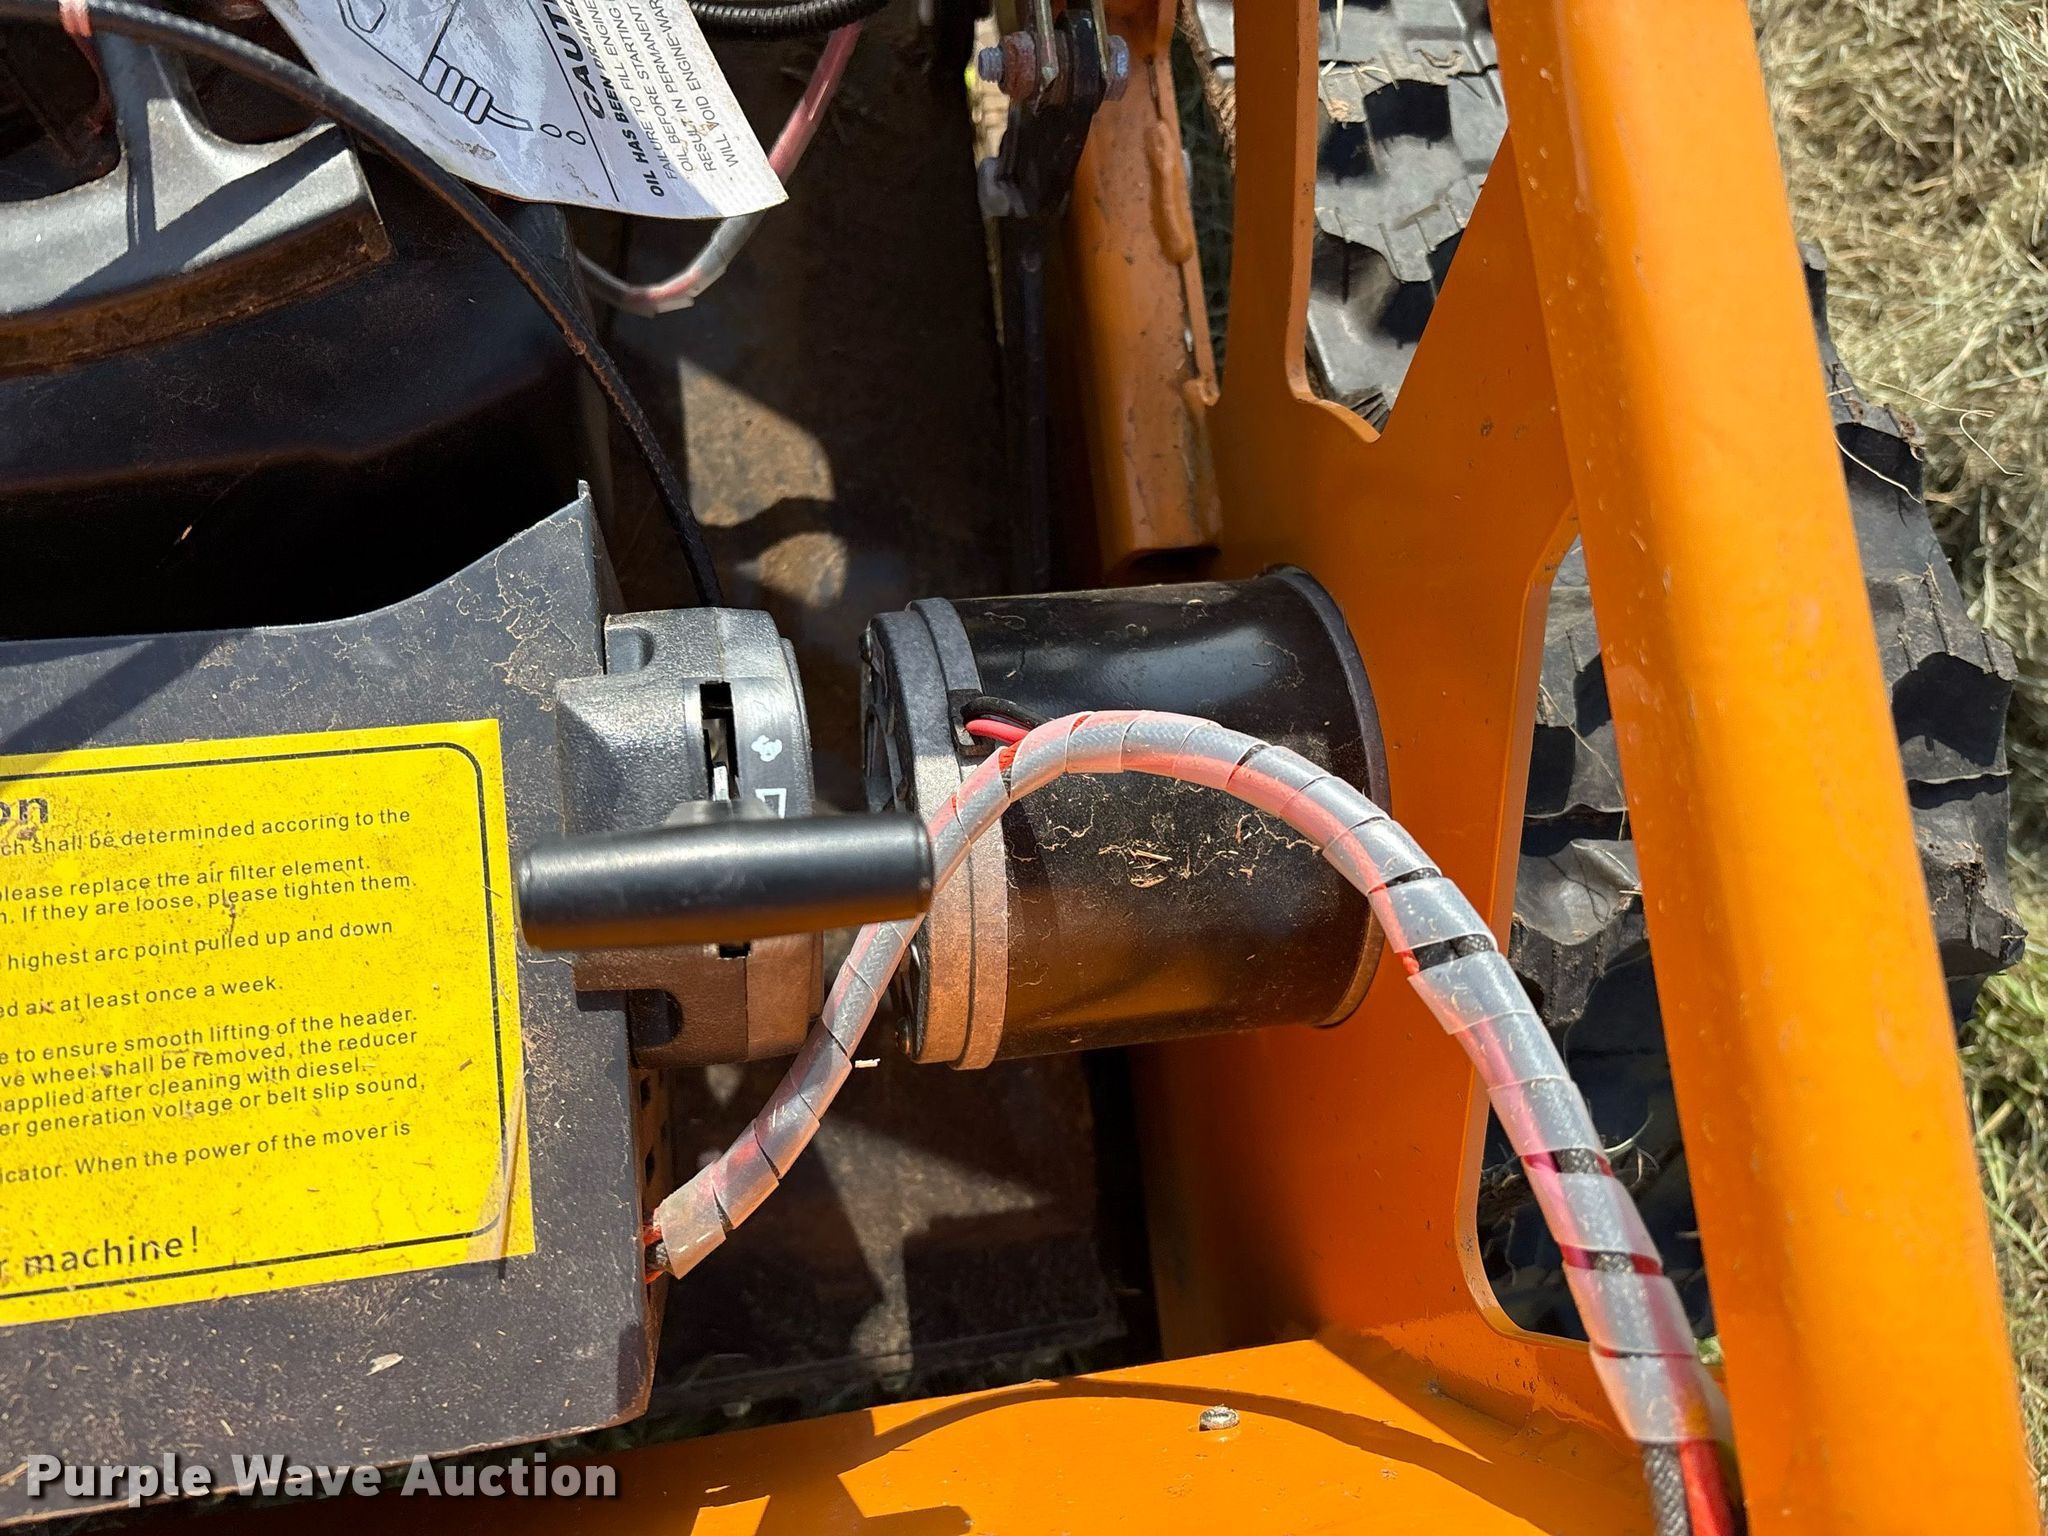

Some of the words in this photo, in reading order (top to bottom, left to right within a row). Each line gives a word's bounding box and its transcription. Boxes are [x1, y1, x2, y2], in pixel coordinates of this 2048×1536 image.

[584, 0, 618, 56] ENGINE
[609, 8, 649, 80] STARTING
[627, 3, 678, 93] PERMANENT
[614, 62, 634, 90] FILL
[666, 35, 701, 91] ENGINE
[600, 75, 629, 123] BEEN
[629, 95, 645, 115] TO
[643, 85, 680, 144] BEFORE
[671, 99, 688, 112] IN
[695, 96, 720, 131] VOID
[622, 129, 649, 164] HAS
[641, 121, 677, 180] FAILURE
[677, 146, 693, 171] OIL
[681, 118, 717, 172] RESULT
[715, 133, 739, 168] WILL
[643, 170, 664, 197] OIL
[32, 834, 82, 853] shall
[90, 833, 114, 848] be
[121, 820, 255, 846] determinded
[262, 814, 349, 834] accoring
[355, 812, 373, 827] to
[380, 809, 410, 823] the
[23, 905, 37, 922] If
[43, 904, 88, 921] they
[95, 900, 129, 916] are
[136, 895, 201, 912] loose,
[208, 888, 277, 909] please
[284, 880, 354, 900] tighten
[361, 875, 416, 891] them.
[71, 877, 150, 897] replace
[158, 872, 190, 888] the
[197, 869, 224, 884] air
[230, 864, 276, 881] filter
[282, 855, 370, 876] element.
[8, 948, 88, 972] highest
[95, 947, 128, 962] arc
[135, 939, 188, 961] point
[195, 931, 258, 955] pulled
[266, 931, 290, 947] up
[297, 924, 333, 942] and
[340, 921, 392, 938] down
[61, 996, 80, 1012] at
[87, 990, 140, 1008] least
[145, 986, 197, 1003] once
[204, 984, 215, 997] a
[222, 976, 283, 994] week.
[16, 1048, 36, 1063] to
[43, 1041, 117, 1060] ensure
[124, 1029, 203, 1051] smooth
[211, 1023, 270, 1042] lifting
[276, 1018, 296, 1035] of
[302, 1016, 334, 1032] the
[340, 1008, 417, 1028] header.
[32, 1062, 95, 1085] wheel
[101, 1055, 153, 1078] shall
[161, 1055, 186, 1071] be
[193, 1042, 293, 1068] removed,
[300, 1039, 332, 1055] the
[339, 1031, 417, 1051] reducer
[27, 1107, 146, 1137] generation
[153, 1098, 233, 1118] voltage
[240, 1095, 260, 1109] or
[267, 1086, 306, 1105] belt
[313, 1082, 349, 1100] slip
[355, 1074, 425, 1095] sound,
[92, 1083, 142, 1100] after
[149, 1073, 240, 1097] cleaning
[247, 1066, 290, 1084] with
[75, 1156, 137, 1175] When
[144, 1151, 178, 1168] the
[185, 1142, 251, 1166] power
[257, 1135, 277, 1153] of
[284, 1133, 316, 1149] the
[323, 1125, 388, 1145] mover
[394, 1121, 411, 1136] is
[24, 1225, 198, 1277] machine!
